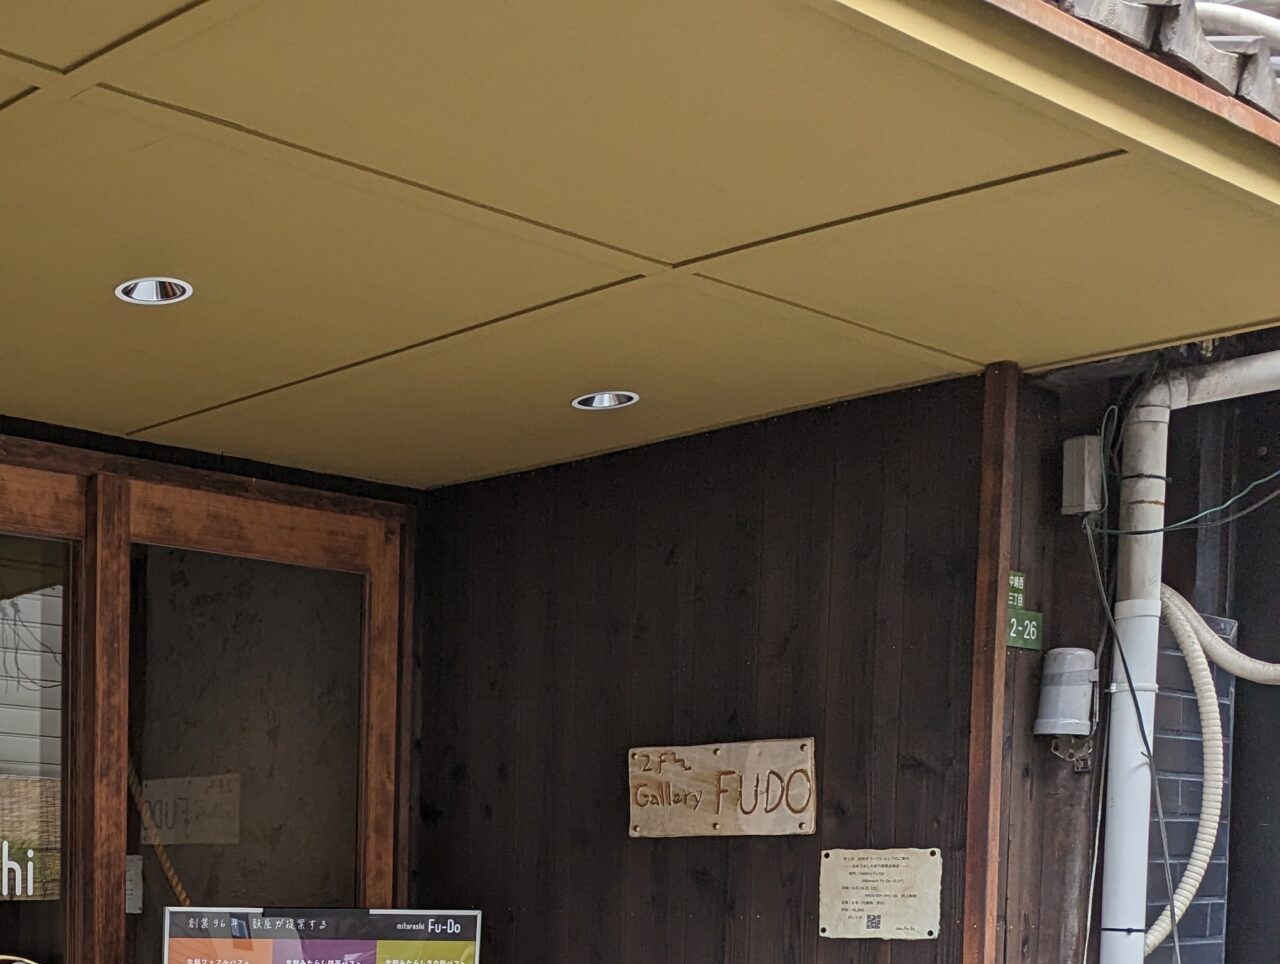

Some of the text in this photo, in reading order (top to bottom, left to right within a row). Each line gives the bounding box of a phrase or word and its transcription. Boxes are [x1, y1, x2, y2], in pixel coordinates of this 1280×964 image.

[1008, 592, 1023, 606] 三丁目
[1010, 618, 1037, 639] 2-26
[634, 783, 703, 811] Gallery
[396, 919, 461, 933] mitarashi Fu-Do
